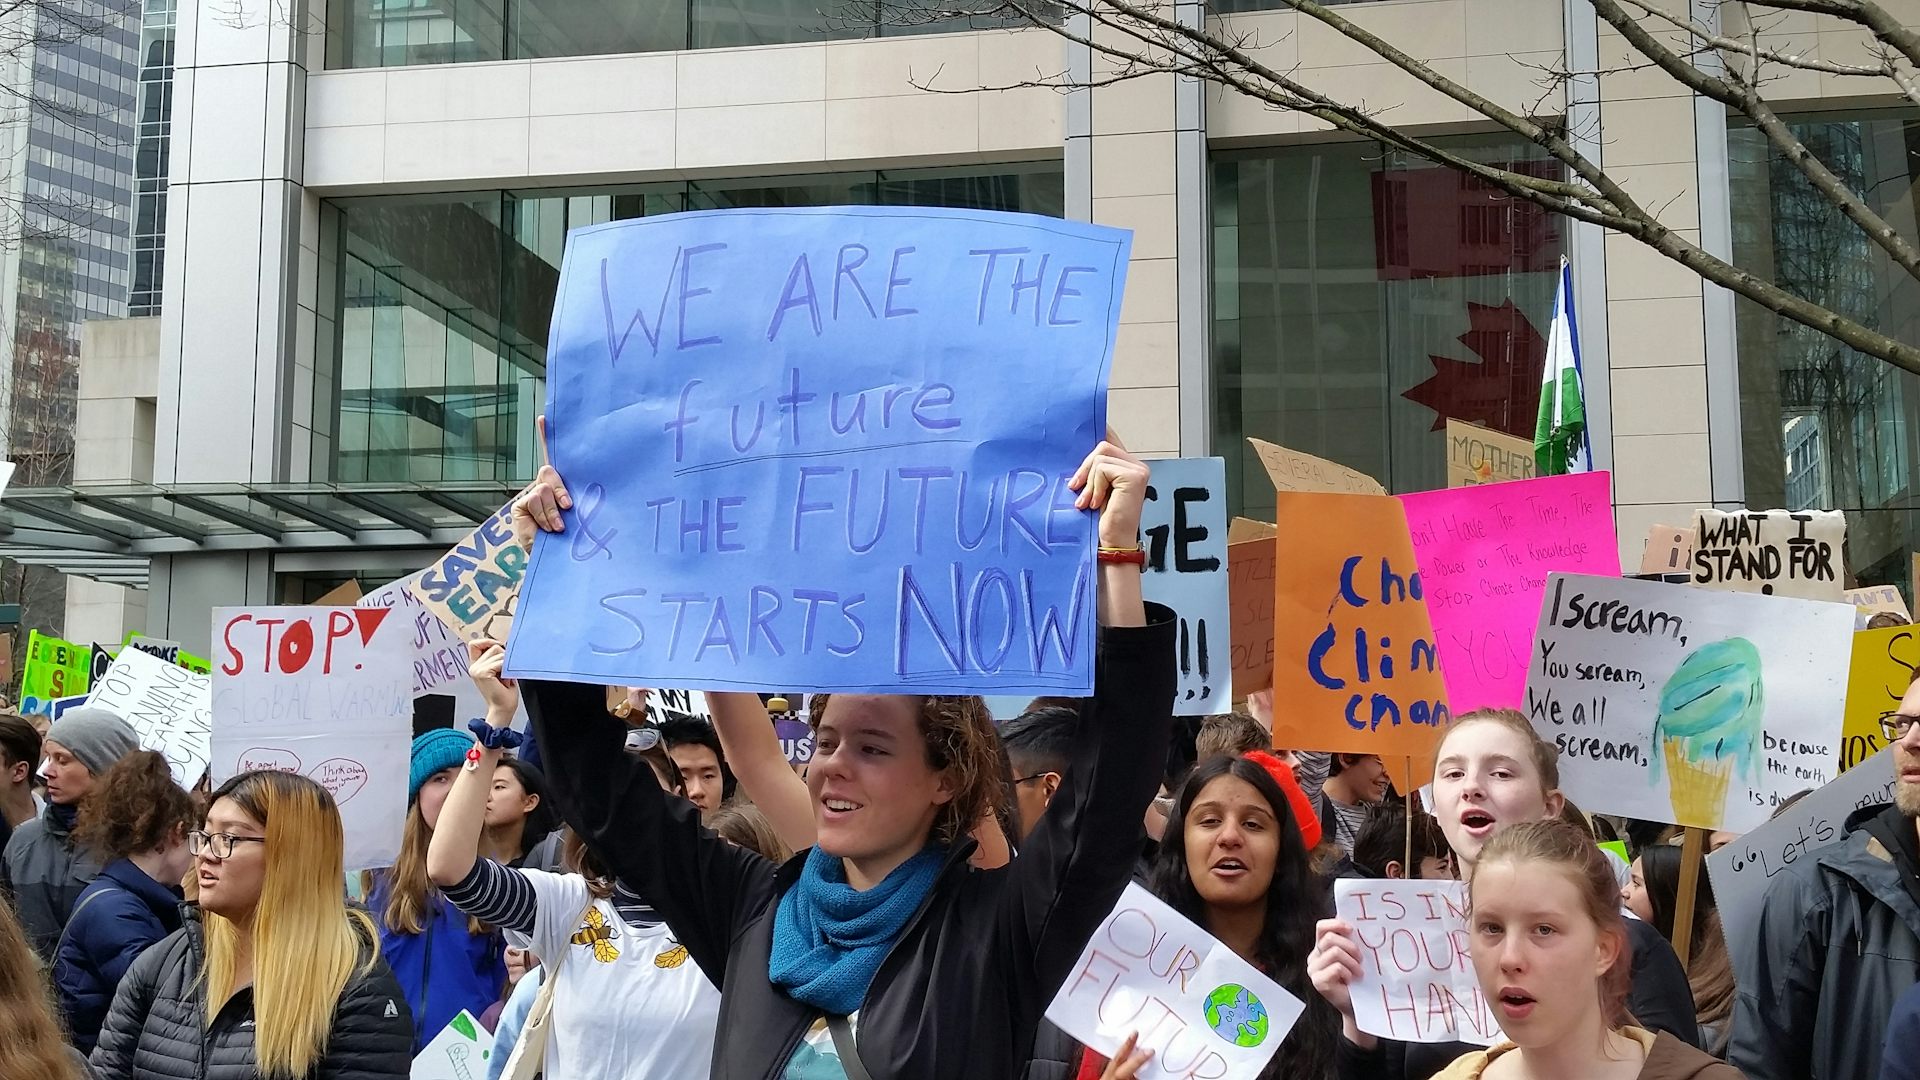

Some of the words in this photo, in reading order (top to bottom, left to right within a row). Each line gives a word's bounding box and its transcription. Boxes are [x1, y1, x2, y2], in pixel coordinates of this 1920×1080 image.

[600, 242, 728, 369] WE
[767, 242, 920, 342] ARE
[968, 246, 1099, 327] THE
[663, 366, 963, 463] future
[1453, 435, 1533, 480] MOTHER
[570, 482, 619, 562] &
[645, 496, 746, 554] THE
[791, 465, 1084, 557] FUTURE
[1412, 520, 1438, 547] on't
[1442, 512, 1488, 543] Have
[1489, 502, 1516, 530] The
[1570, 492, 1593, 517] The
[1700, 513, 1768, 549] WHAT
[1786, 514, 1816, 545] I
[420, 514, 514, 602] SAVE
[1433, 556, 1466, 577] Power
[1477, 558, 1489, 569] or
[1496, 543, 1522, 568] The
[1527, 541, 1589, 564] Knowledge
[1694, 544, 1783, 585] STAND
[1789, 542, 1835, 582] FOR
[446, 544, 528, 625] EAR
[1433, 588, 1473, 609] Stop
[1852, 588, 1895, 606] AN'T
[588, 584, 865, 667] STARTS
[893, 560, 1091, 677] NOW
[1308, 622, 1442, 690] Clim
[1540, 638, 1569, 679] You
[91, 663, 137, 709] TOP
[125, 663, 192, 737] ENYING
[213, 680, 313, 728] GLOBAL
[1528, 686, 1565, 726] We
[1572, 695, 1607, 727] all
[141, 688, 198, 754] EARTH
[188, 673, 211, 691] IS
[1555, 732, 1648, 768] scream,
[1763, 730, 1829, 757] because
[1767, 757, 1789, 777] the
[1794, 763, 1827, 785] earth
[1748, 786, 1765, 807] is
[1349, 891, 1407, 921] IS
[1416, 891, 1471, 921] IN
[1108, 908, 1200, 994] OUR
[1357, 926, 1472, 977] YOUR
[1068, 949, 1228, 1080] FUTUR
